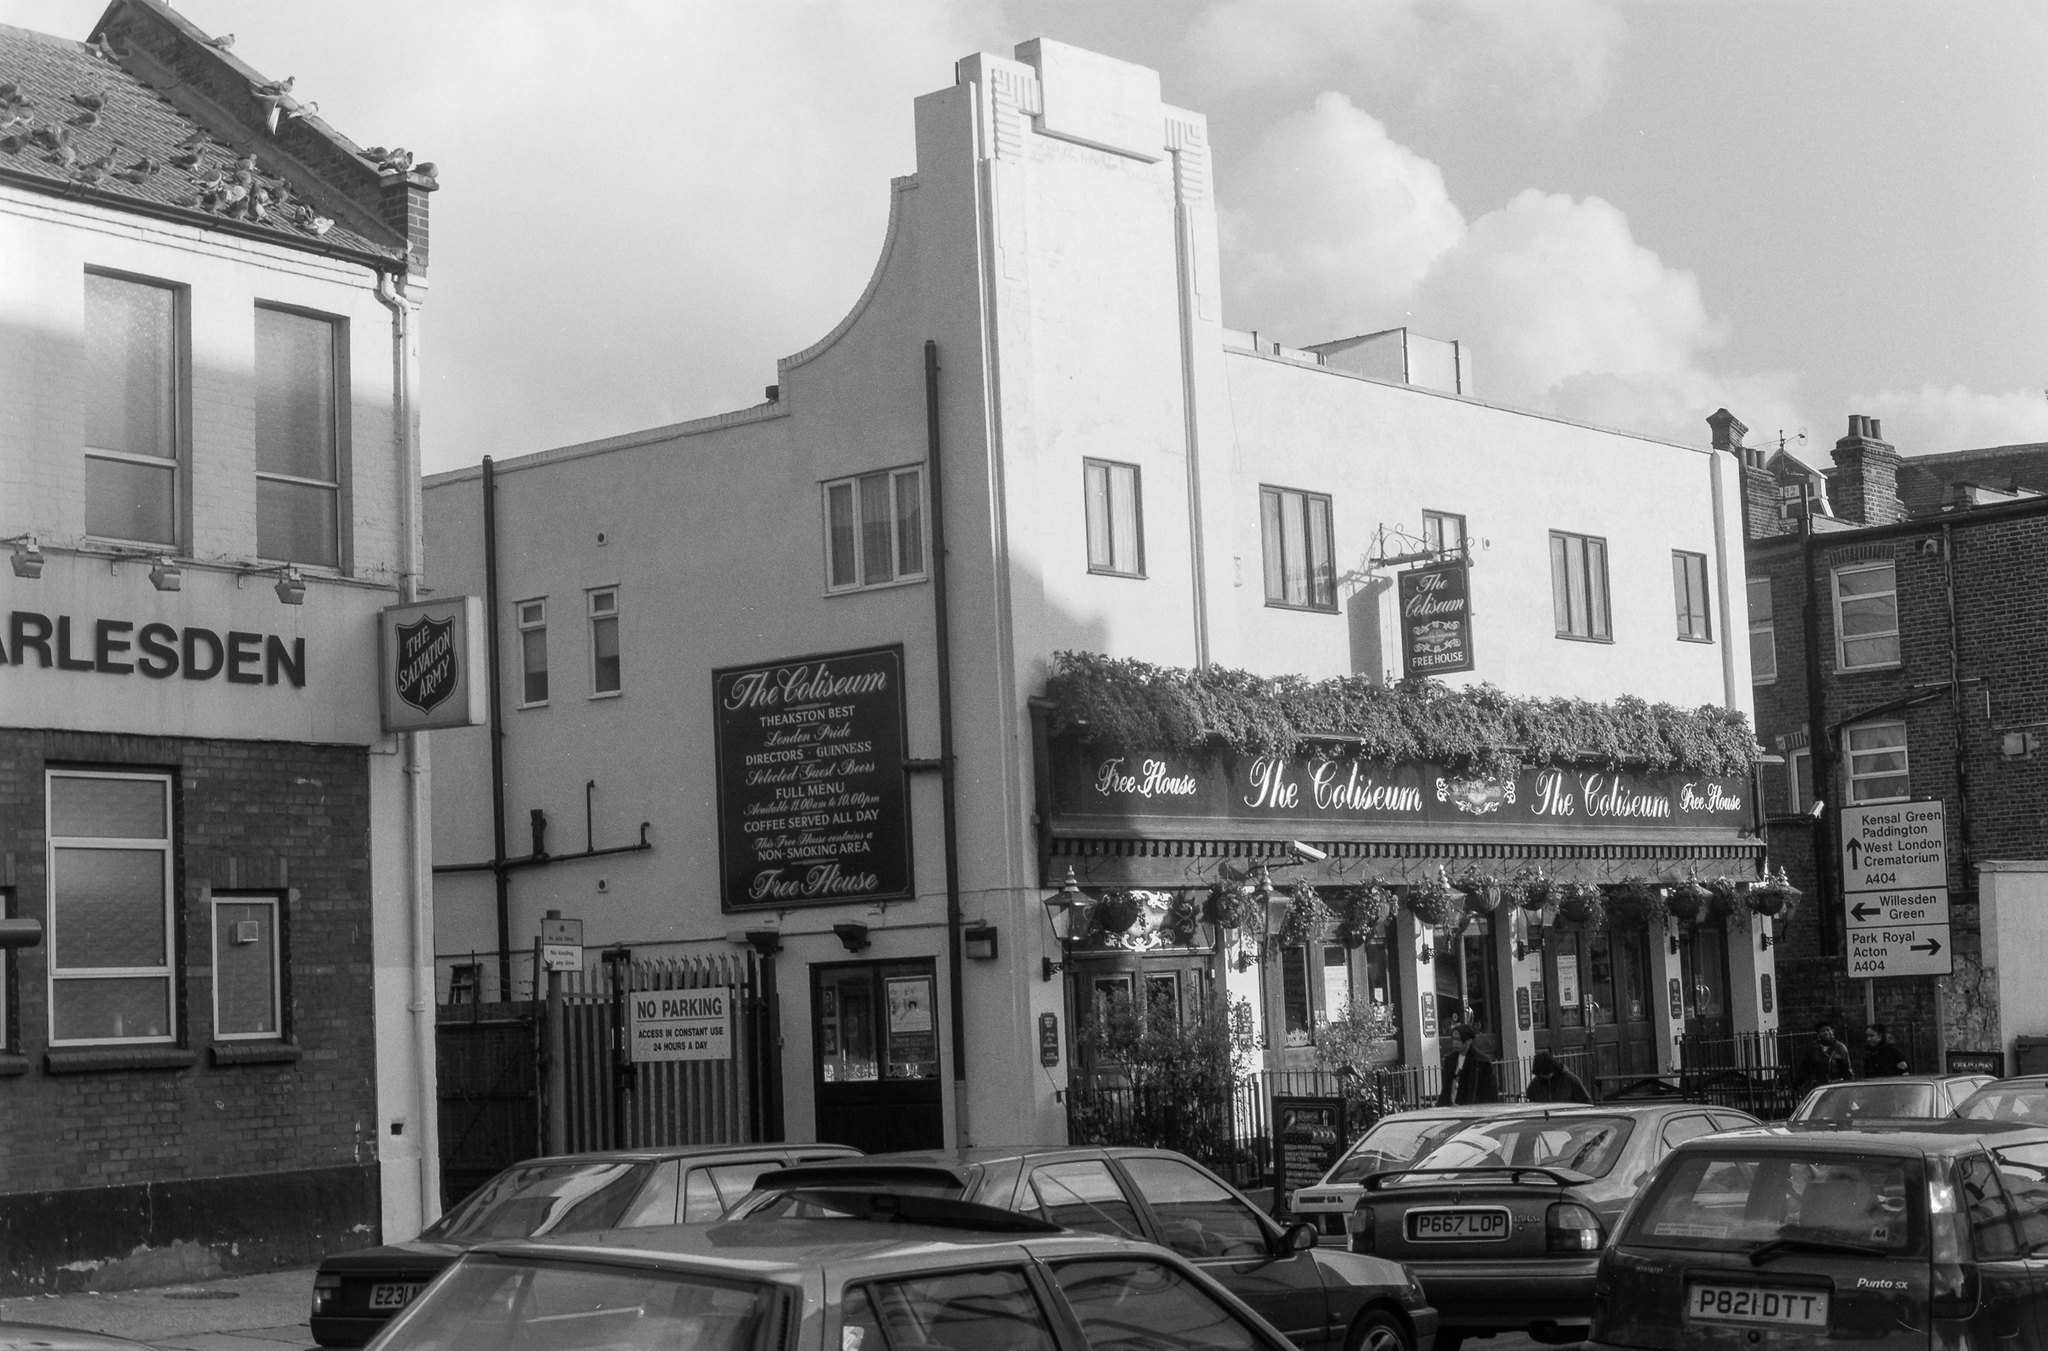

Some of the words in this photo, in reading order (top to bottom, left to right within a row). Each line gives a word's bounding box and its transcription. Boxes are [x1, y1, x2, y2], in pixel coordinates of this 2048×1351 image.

[1416, 573, 1447, 592] The
[1404, 593, 1464, 617] Coliseum
[0, 610, 306, 688] RLESDEN
[406, 625, 430, 658] THE
[400, 627, 451, 692] SALVATION
[1412, 655, 1433, 667] FREE
[1434, 651, 1463, 664] HOUSE
[419, 654, 450, 703] ARMY
[724, 671, 778, 710] The
[777, 664, 887, 703] Coliseum
[760, 709, 826, 727] THEAKSTON
[828, 705, 855, 719] BEST
[764, 730, 810, 747] London
[814, 722, 850, 742] Pride
[746, 750, 803, 766] DIRECTORS
[816, 741, 872, 758] GUINNESS
[746, 765, 799, 786] Selected
[800, 761, 832, 781] Guest
[838, 759, 875, 776] Beers
[1095, 757, 1136, 796] Free
[1137, 759, 1196, 798] House
[776, 785, 805, 799] FULL
[808, 782, 845, 797] MENU
[1244, 756, 1299, 808] The
[1308, 759, 1422, 811] Coliseum
[1530, 767, 1574, 816] The
[1579, 772, 1670, 818] Coliseum
[1679, 782, 1705, 811] Free
[1703, 783, 1741, 813] House
[744, 801, 789, 816] Available
[828, 800, 836, 809] to
[744, 818, 785, 833] COFFEE
[788, 814, 829, 829] SERVED
[833, 812, 852, 825] ALL
[856, 809, 879, 822] DAY
[1862, 812, 1900, 825] Kensal
[1905, 811, 1941, 823] Green
[752, 836, 775, 851] This
[776, 835, 796, 849] Free
[797, 831, 827, 846] House
[828, 831, 864, 844] contains
[866, 831, 873, 840] a
[1862, 825, 1928, 838] Paddington
[758, 845, 837, 861] NON-SMOKING
[839, 841, 870, 854] AREA
[1864, 841, 1892, 853] West
[1898, 839, 1942, 851] London
[1864, 853, 1939, 867] Crematorium
[749, 868, 800, 899] Free
[800, 864, 878, 895] House
[1865, 873, 1896, 884] A404
[1879, 894, 1937, 906] Willesden
[1889, 909, 1925, 920] Green
[1852, 933, 1878, 944] Park
[1883, 931, 1915, 943] Royal
[1853, 947, 1887, 957] Acton
[1854, 961, 1885, 972] A404
[637, 1000, 656, 1018] NO
[662, 997, 722, 1017] PARKING
[639, 1029, 663, 1038] ACCESS
[666, 1029, 672, 1037] IN
[675, 1027, 708, 1037] CONSTANT
[710, 1026, 723, 1035] USE
[653, 1043, 661, 1051] 24
[664, 1041, 685, 1051] HOURS
[688, 1041, 693, 1050] A
[695, 1041, 708, 1050] DAY
[1420, 1216, 1464, 1232] P667
[1469, 1215, 1503, 1232] LOP
[1873, 1230, 1886, 1238] AA
[1857, 1278, 1893, 1288] Punto
